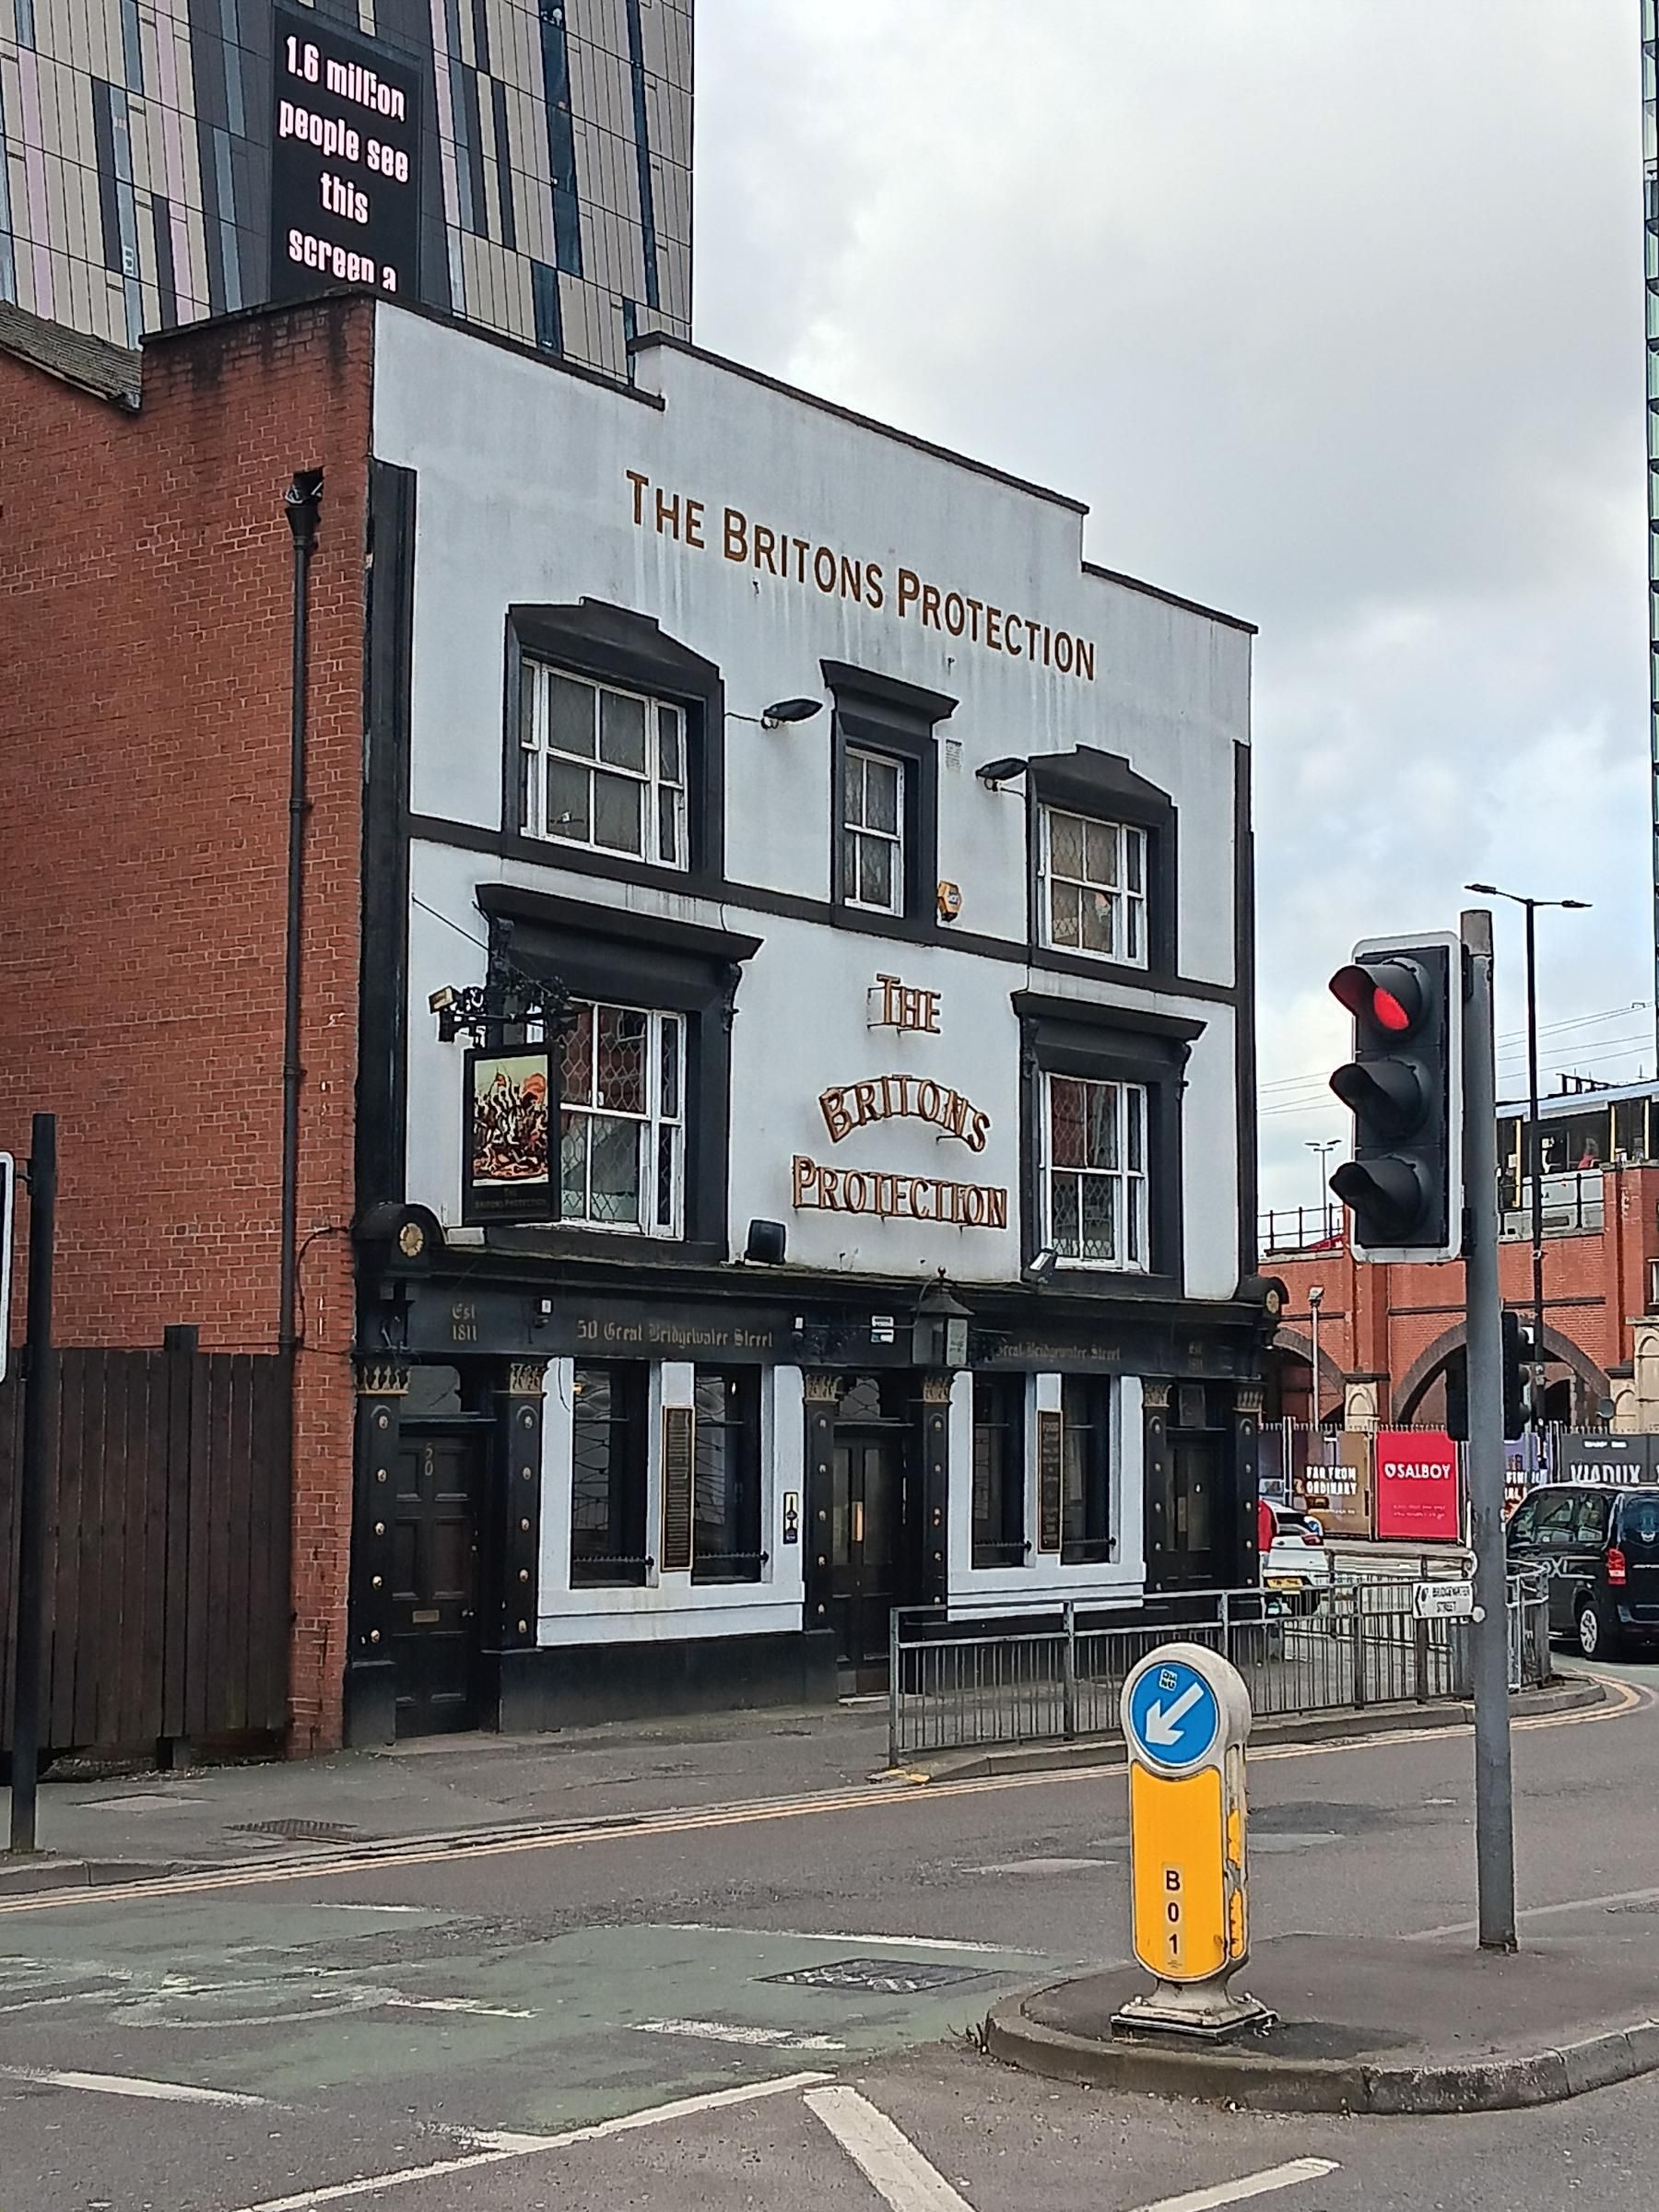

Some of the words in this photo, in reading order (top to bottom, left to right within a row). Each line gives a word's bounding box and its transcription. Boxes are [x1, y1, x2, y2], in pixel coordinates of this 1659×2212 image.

[287, 35, 319, 83] 1.6
[326, 58, 405, 122] million
[279, 100, 359, 161] people
[367, 139, 408, 182] see
[321, 171, 369, 224] this
[288, 229, 374, 284] screen
[382, 265, 396, 292] a
[626, 469, 705, 549] THE
[724, 507, 884, 608] BRITONS
[898, 568, 1095, 681] PROTECTION
[877, 972, 942, 1034] THE
[819, 1074, 991, 1152] BRITONS
[792, 1155, 1007, 1230] PROTECTION
[453, 1324, 477, 1341] 1811
[577, 1320, 598, 1339] 50
[604, 1322, 642, 1341] Great
[734, 1327, 772, 1347] Street
[1397, 1464, 1451, 1479] SALBOY
